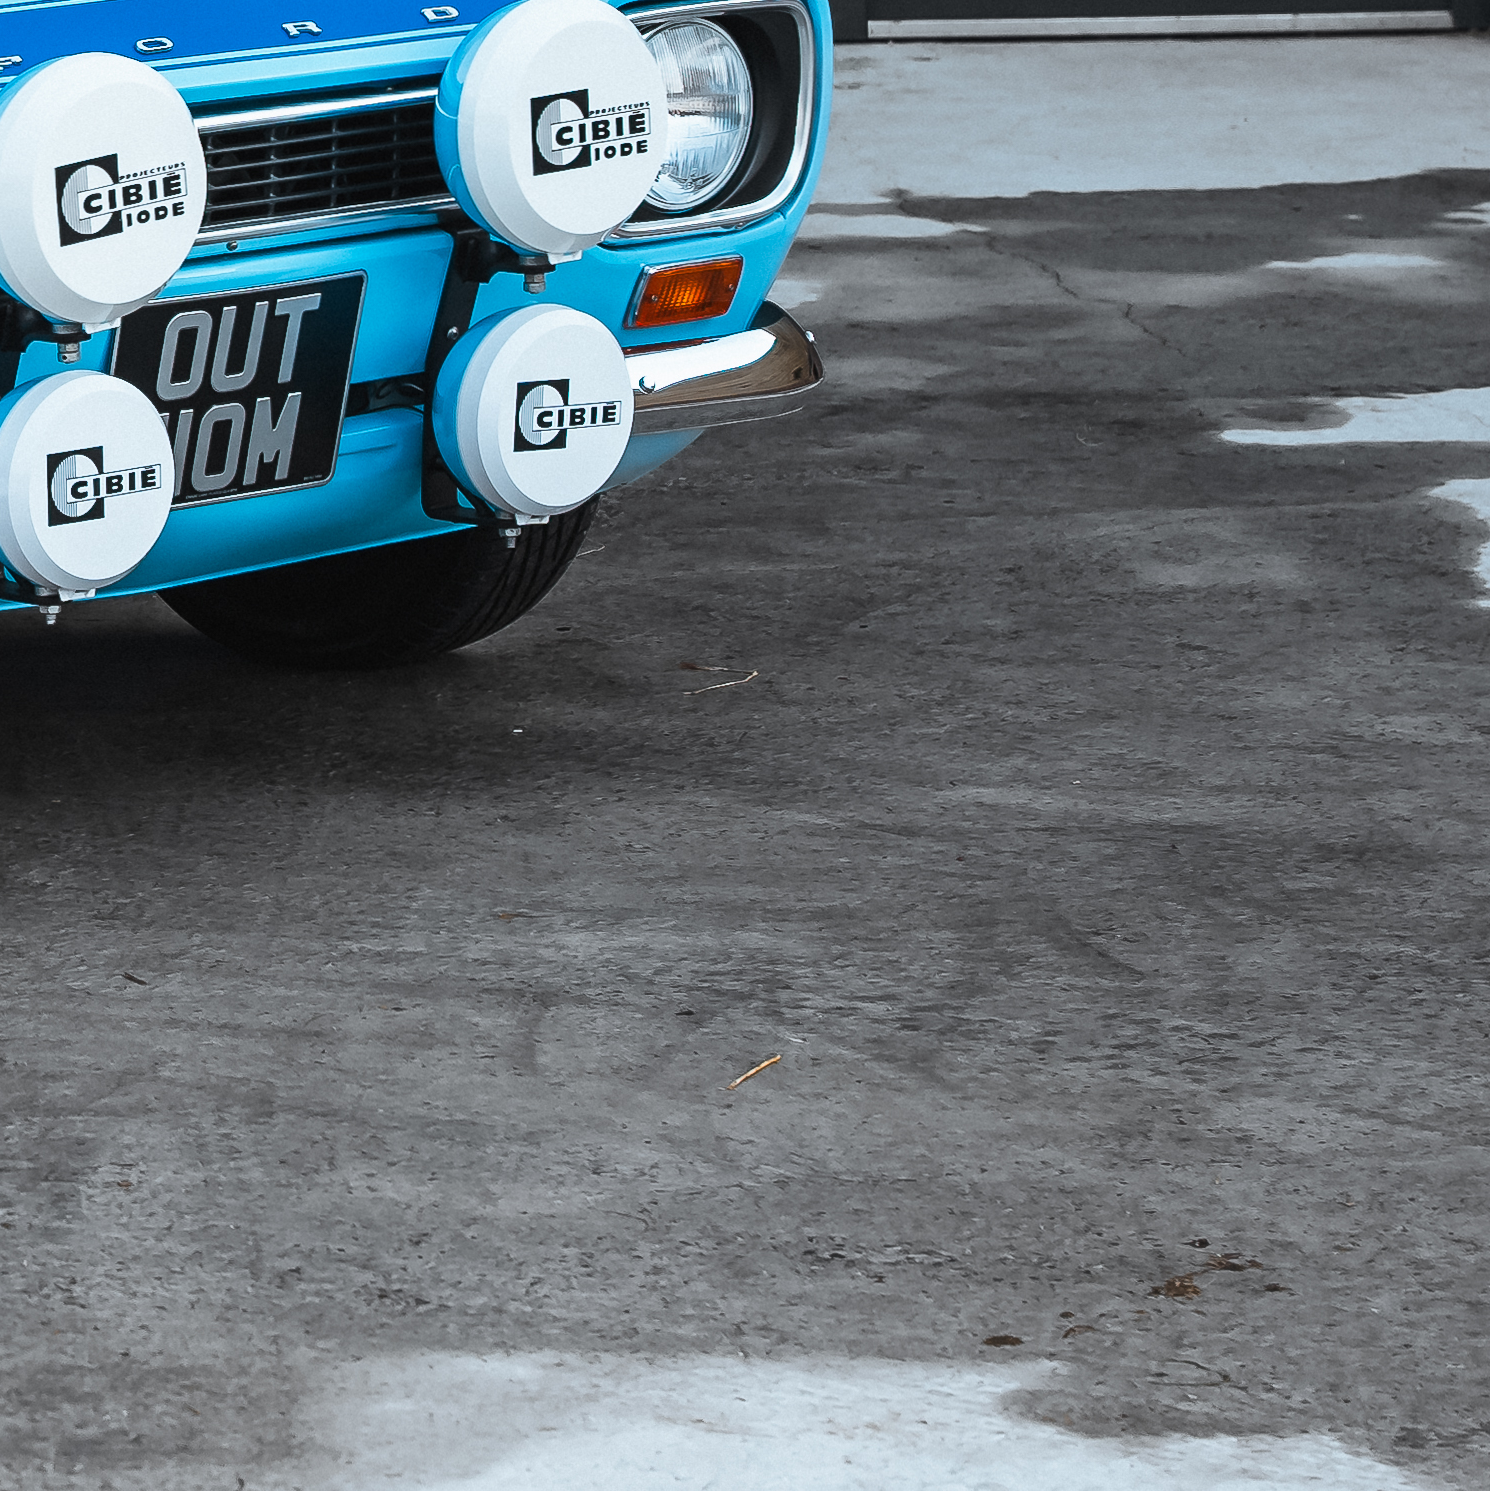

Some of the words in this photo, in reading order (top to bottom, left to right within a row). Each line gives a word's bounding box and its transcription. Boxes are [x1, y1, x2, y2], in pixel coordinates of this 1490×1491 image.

[588, 101, 650, 116] PROJECTEURS
[594, 140, 648, 161] IODE
[119, 161, 186, 181] PROJECTEURS
[126, 201, 185, 227] IODE
[156, 293, 321, 401] OUT
